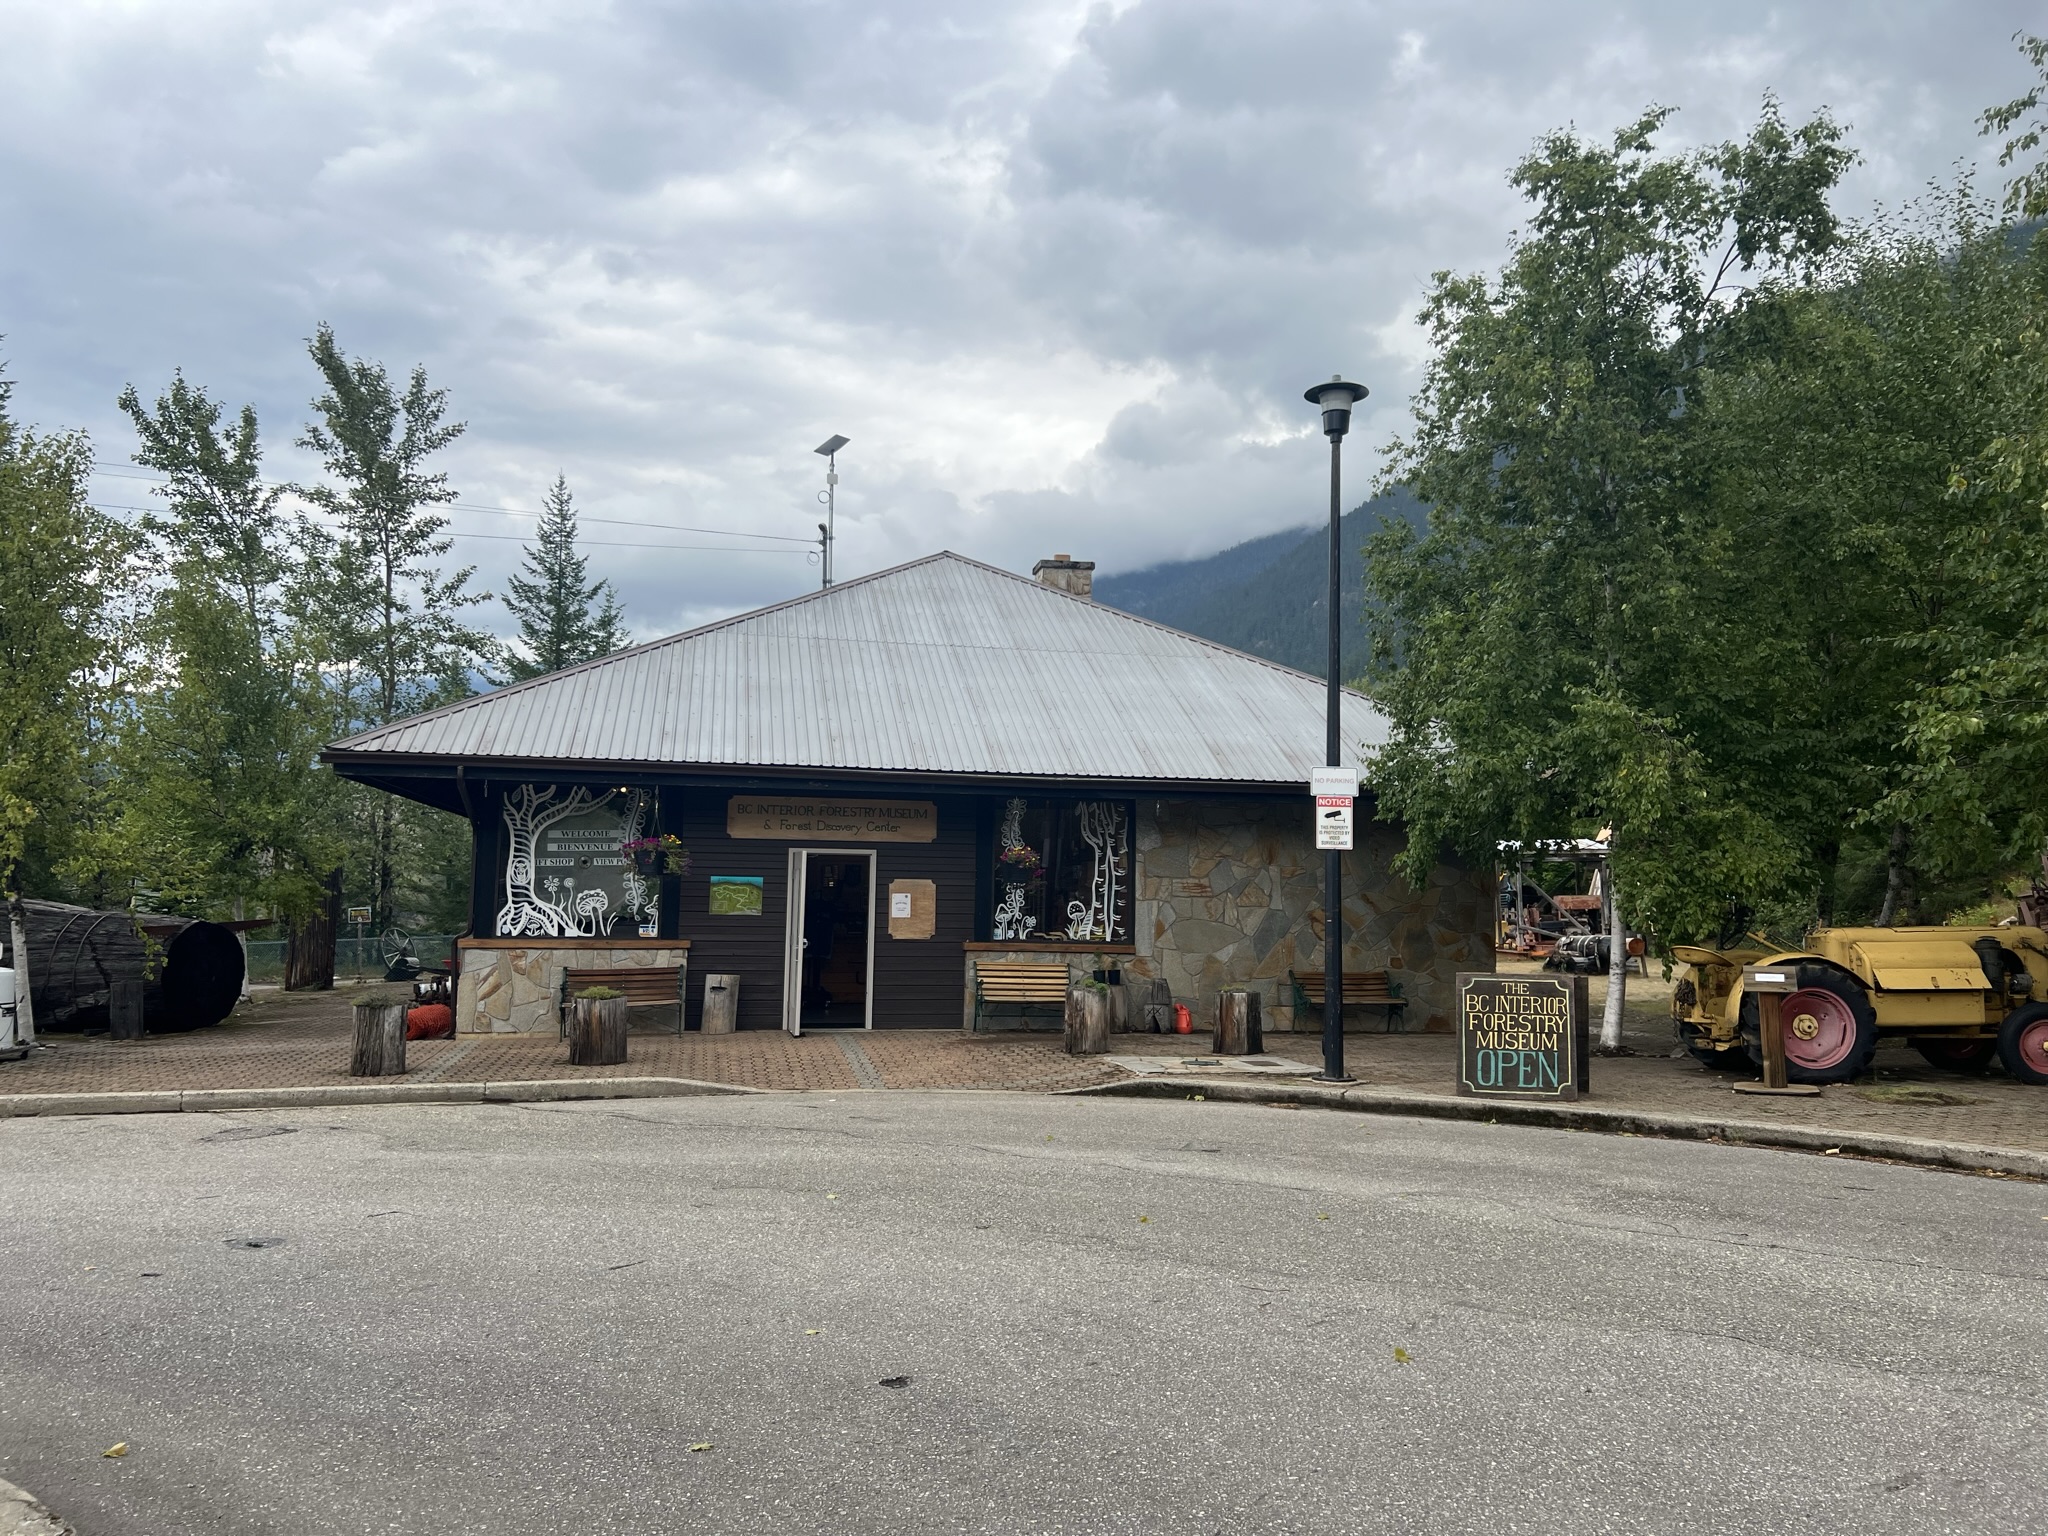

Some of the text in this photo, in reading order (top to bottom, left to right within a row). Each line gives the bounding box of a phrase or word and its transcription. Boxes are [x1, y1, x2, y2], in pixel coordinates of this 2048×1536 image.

[737, 803, 928, 819] BC INTERIOR FORESTRY MUSEUM
[763, 819, 901, 836] & Forest Discovery Center
[557, 843, 614, 851] BIENVENUE
[535, 858, 573, 866] IFT SHOP
[1501, 982, 1530, 995] THE
[1465, 994, 1567, 1015] BC INTERIOR
[1468, 1012, 1567, 1033] FORESTRY
[1475, 1031, 1558, 1051] MUSEUM
[1477, 1049, 1559, 1088] OPEN
